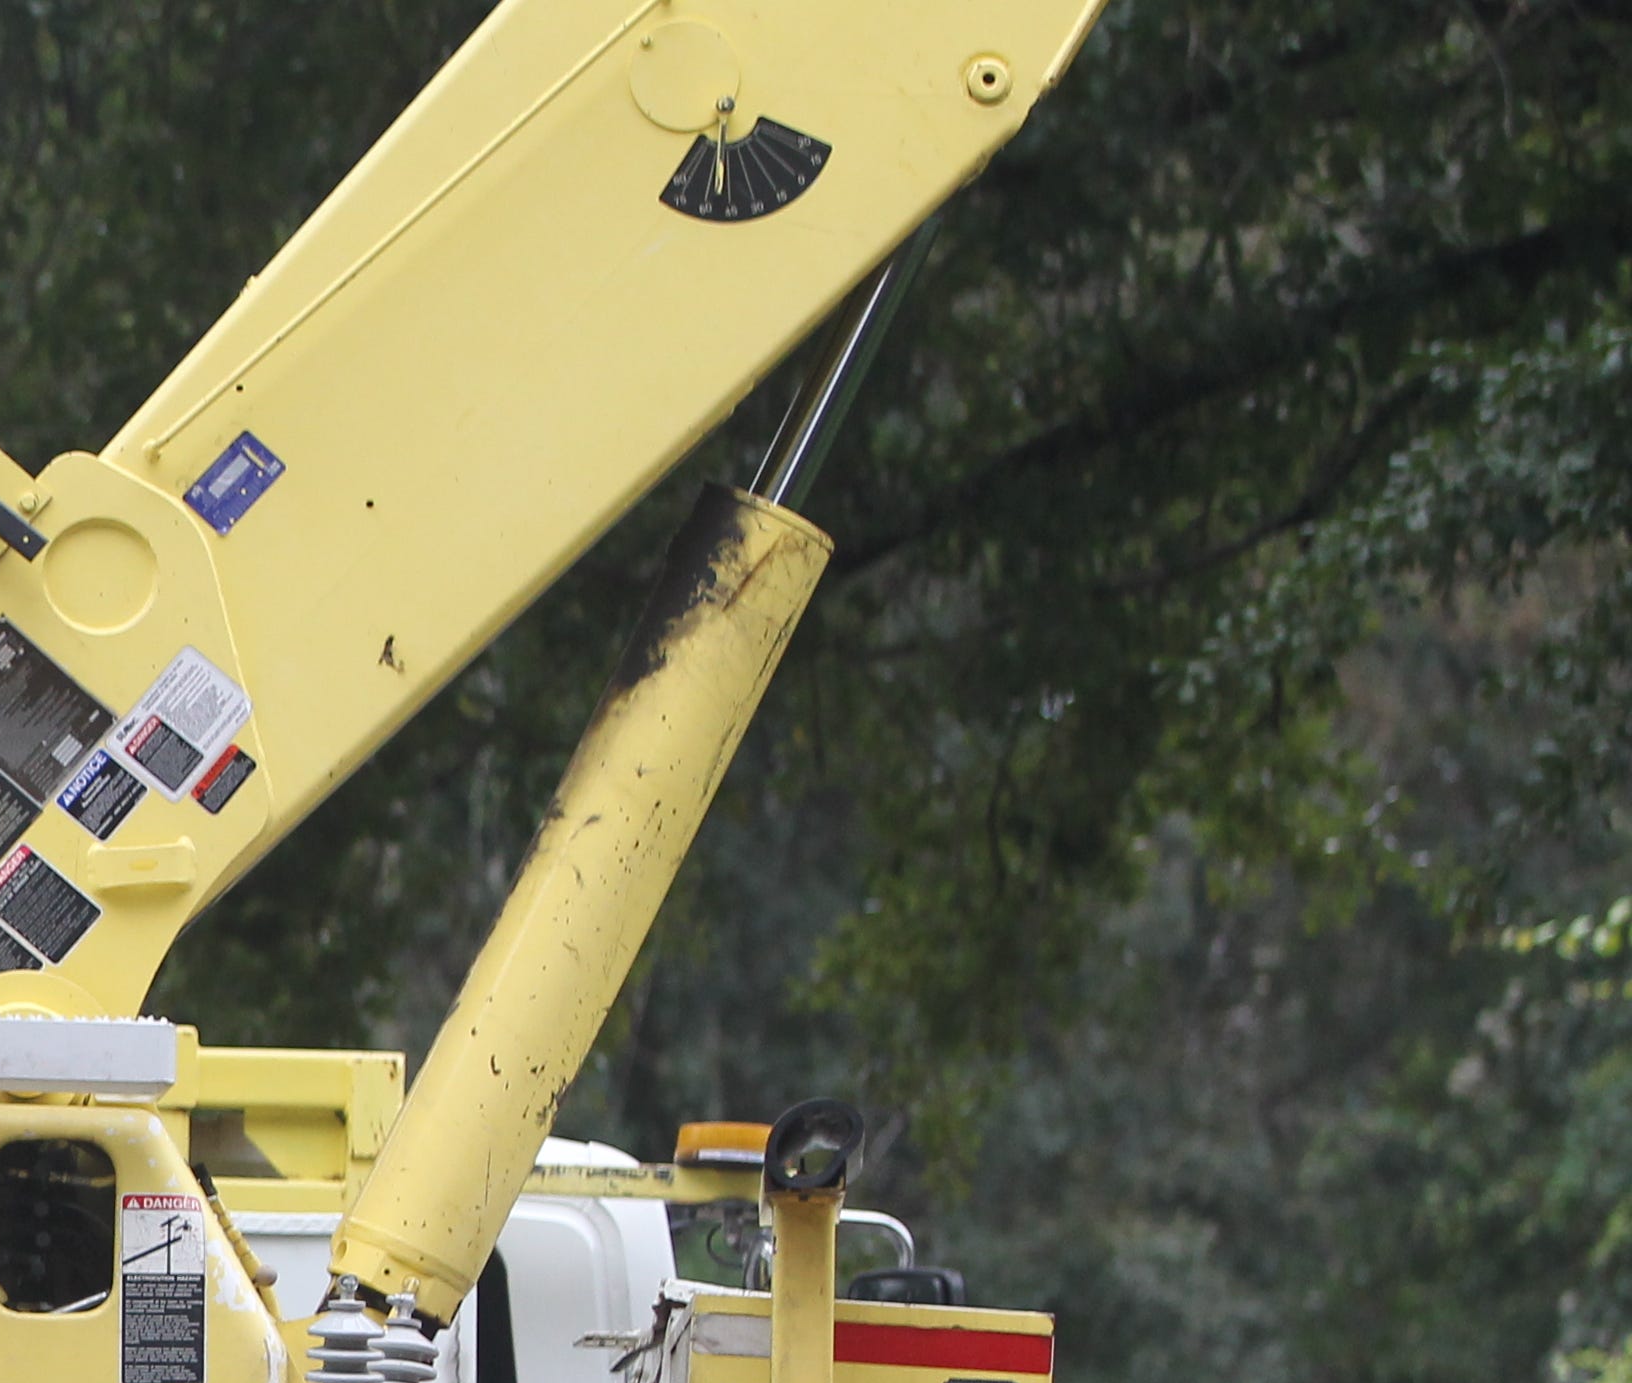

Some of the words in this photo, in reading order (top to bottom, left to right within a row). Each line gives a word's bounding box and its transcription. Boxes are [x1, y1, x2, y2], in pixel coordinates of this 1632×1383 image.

[699, 203, 712, 215] 60
[68, 752, 107, 796] NOTICE
[143, 1198, 200, 1211] DANGER
